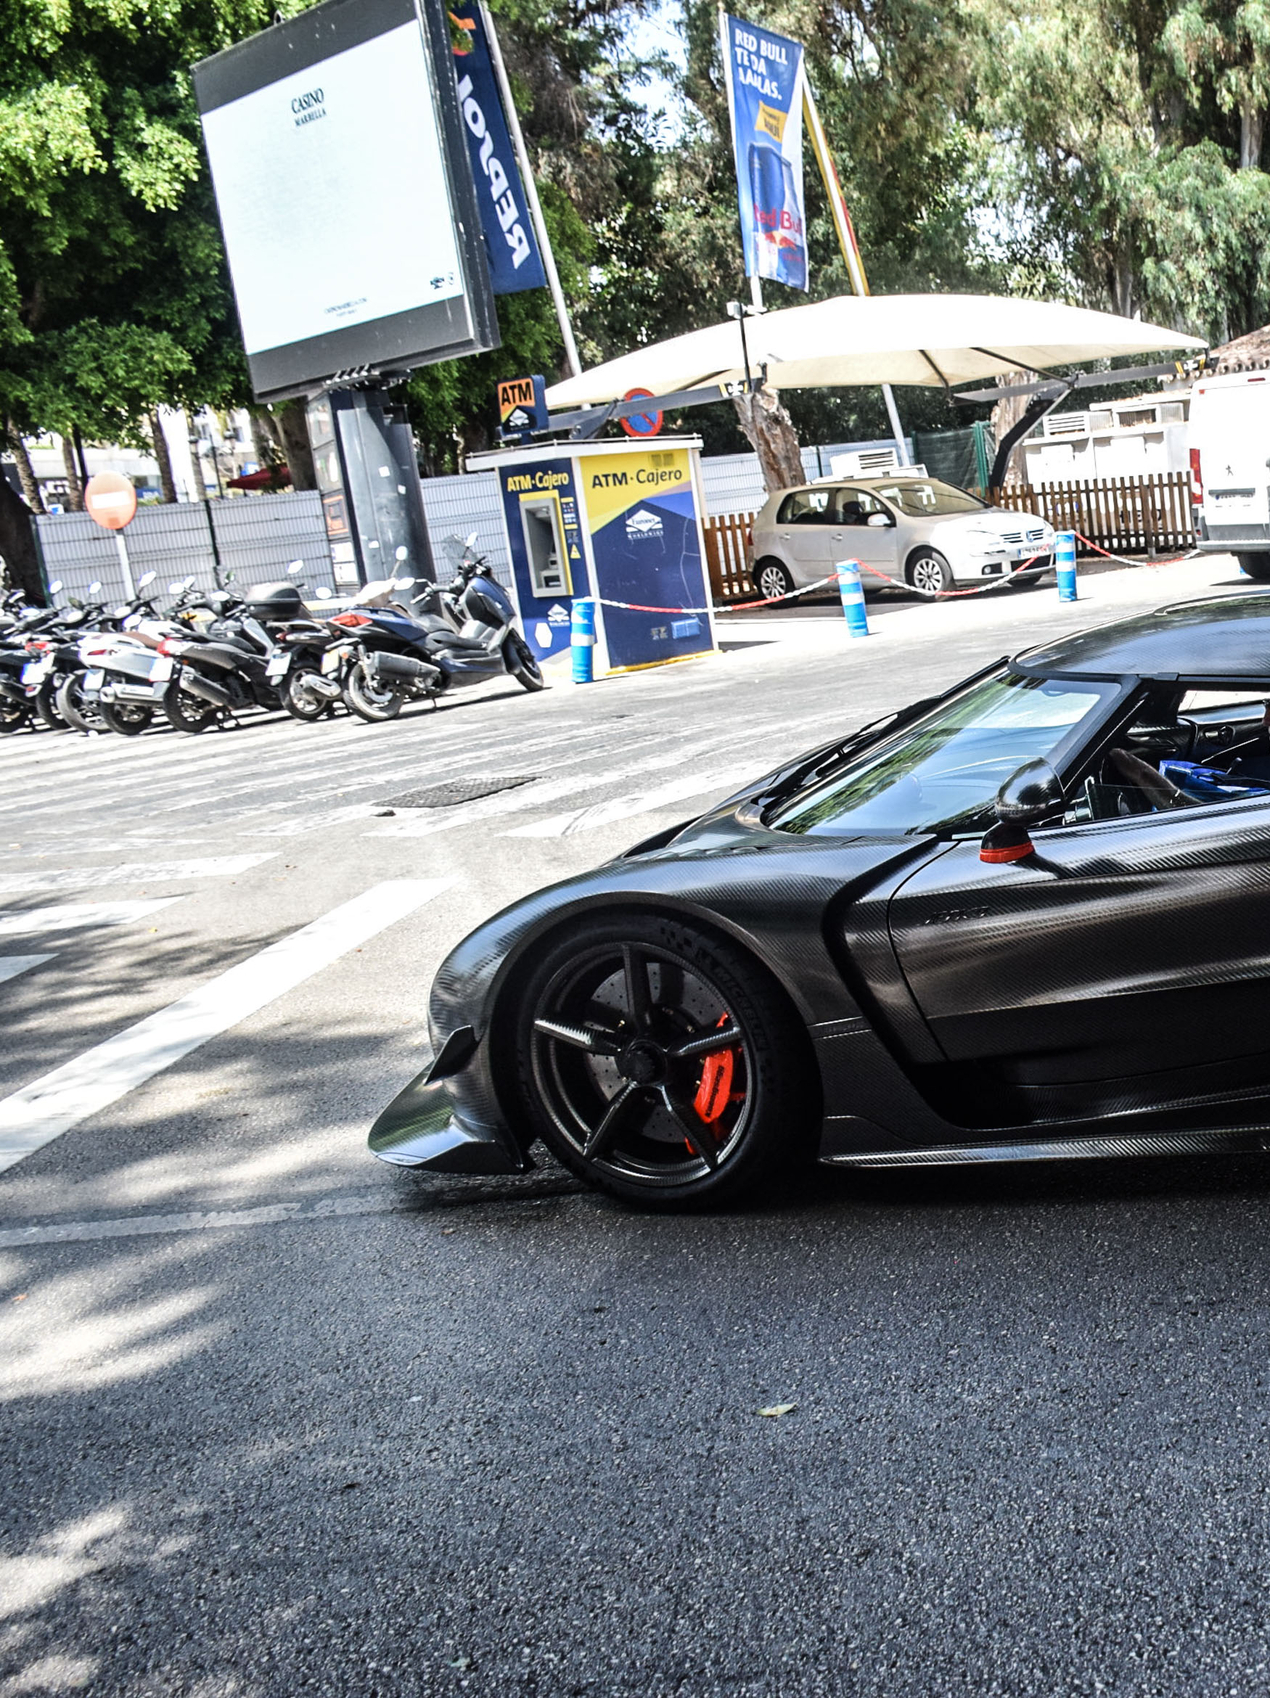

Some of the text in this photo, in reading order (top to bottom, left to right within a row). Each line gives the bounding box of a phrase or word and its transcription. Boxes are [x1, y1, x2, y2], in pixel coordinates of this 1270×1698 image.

[734, 28, 788, 65] RED BULL
[735, 47, 767, 76] TE DA
[291, 87, 325, 114] CASINO
[501, 381, 532, 406] ATM
[507, 470, 569, 492] ATM Cajero
[591, 468, 683, 489] ATM Cajero
